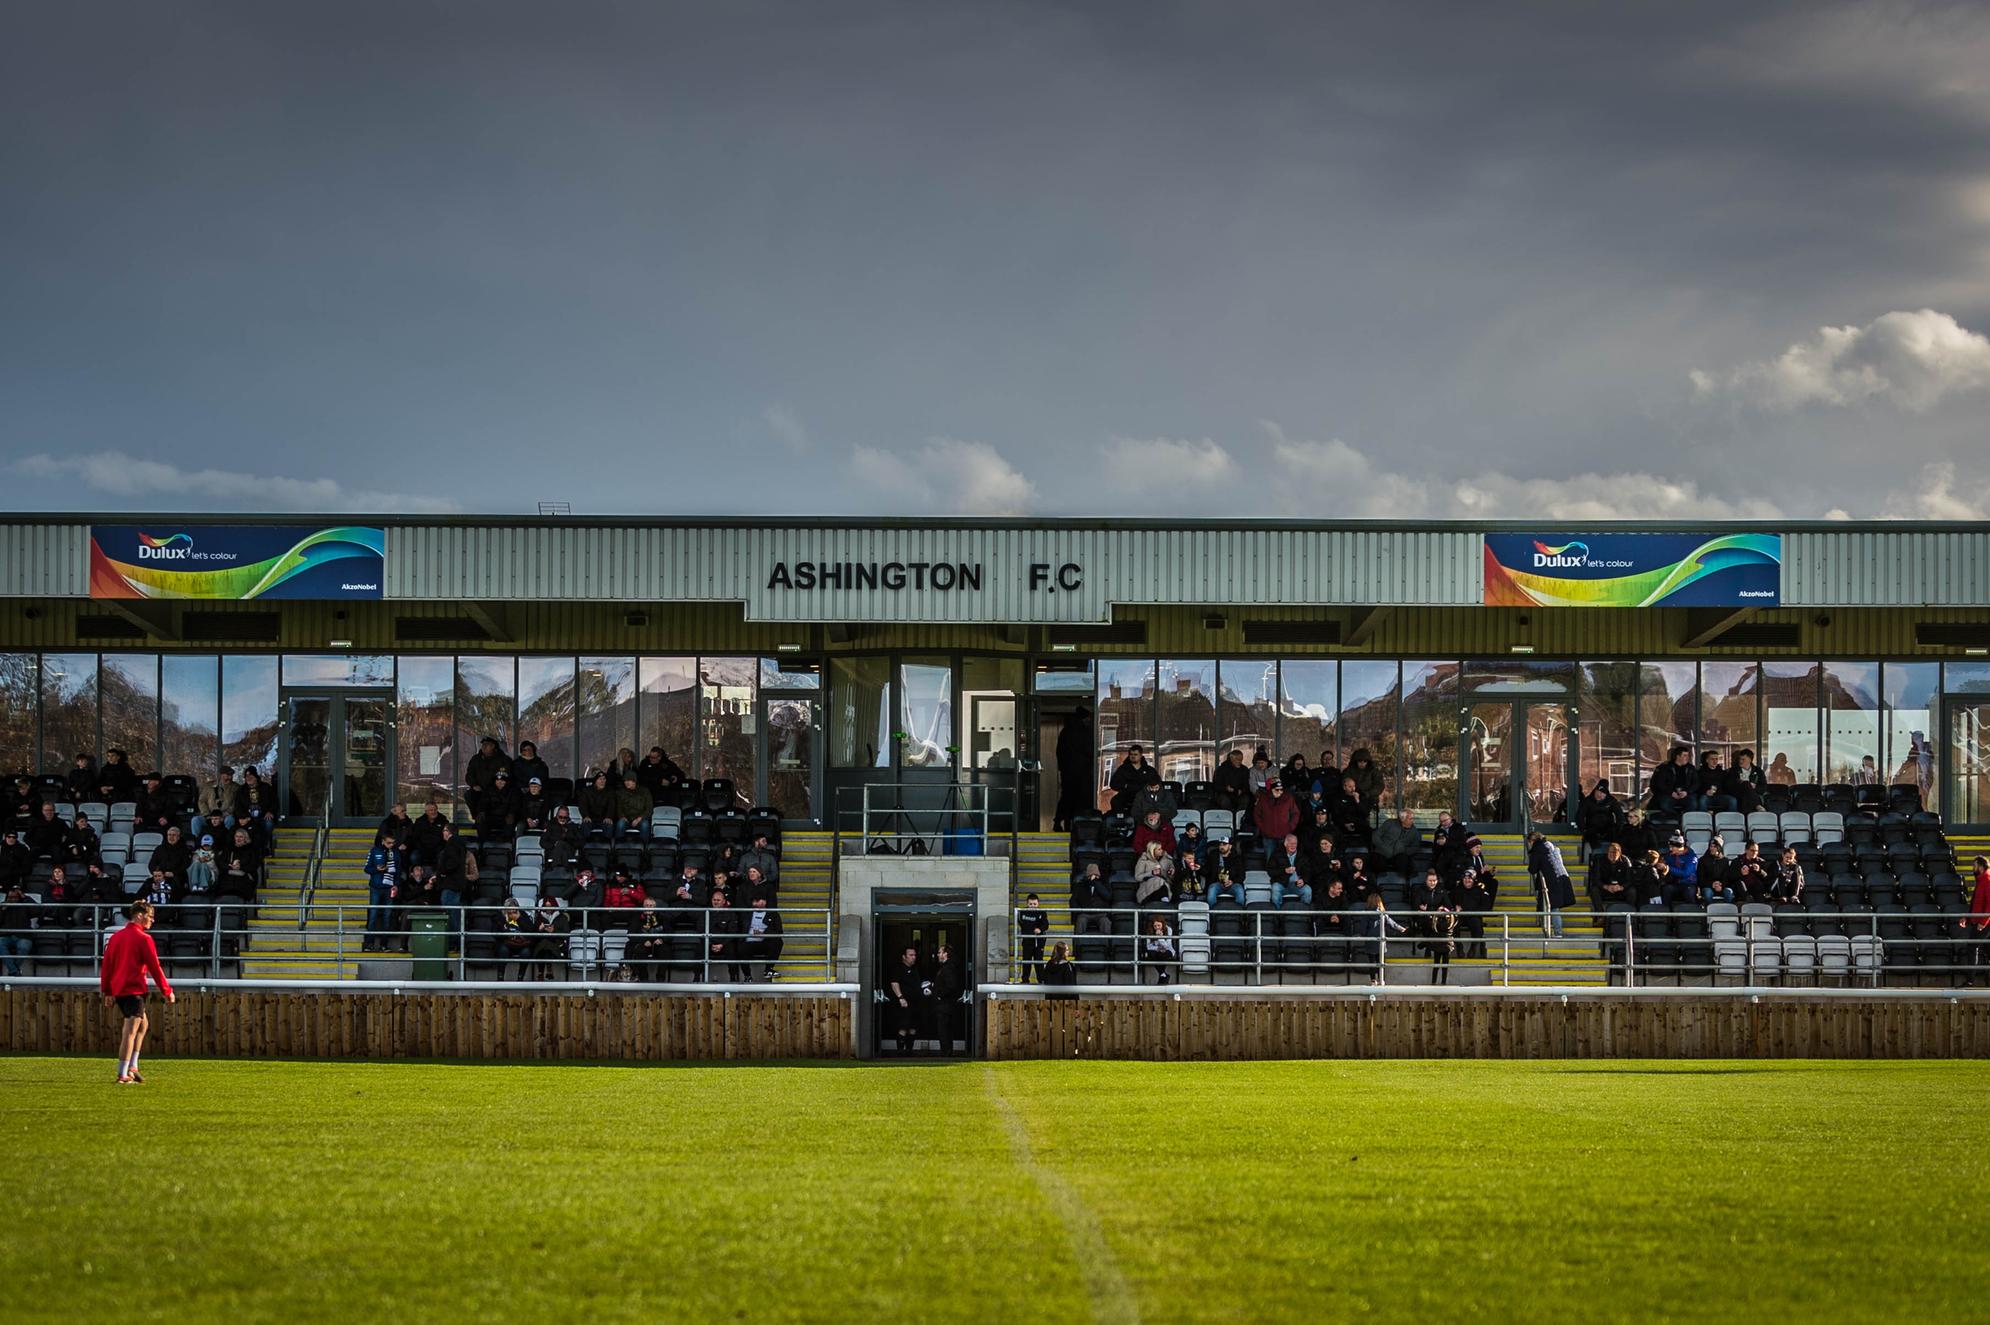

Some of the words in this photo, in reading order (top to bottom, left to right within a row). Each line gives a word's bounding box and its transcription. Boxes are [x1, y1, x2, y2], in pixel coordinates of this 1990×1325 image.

[138, 545, 186, 559] Dulux
[191, 552, 208, 560] let's
[209, 552, 238, 560] colour
[1533, 553, 1581, 568] Dulux
[1587, 560, 1605, 568] let's
[1606, 560, 1634, 568] colour
[767, 562, 981, 590] ASHINGTON
[1029, 563, 1082, 594] F.C
